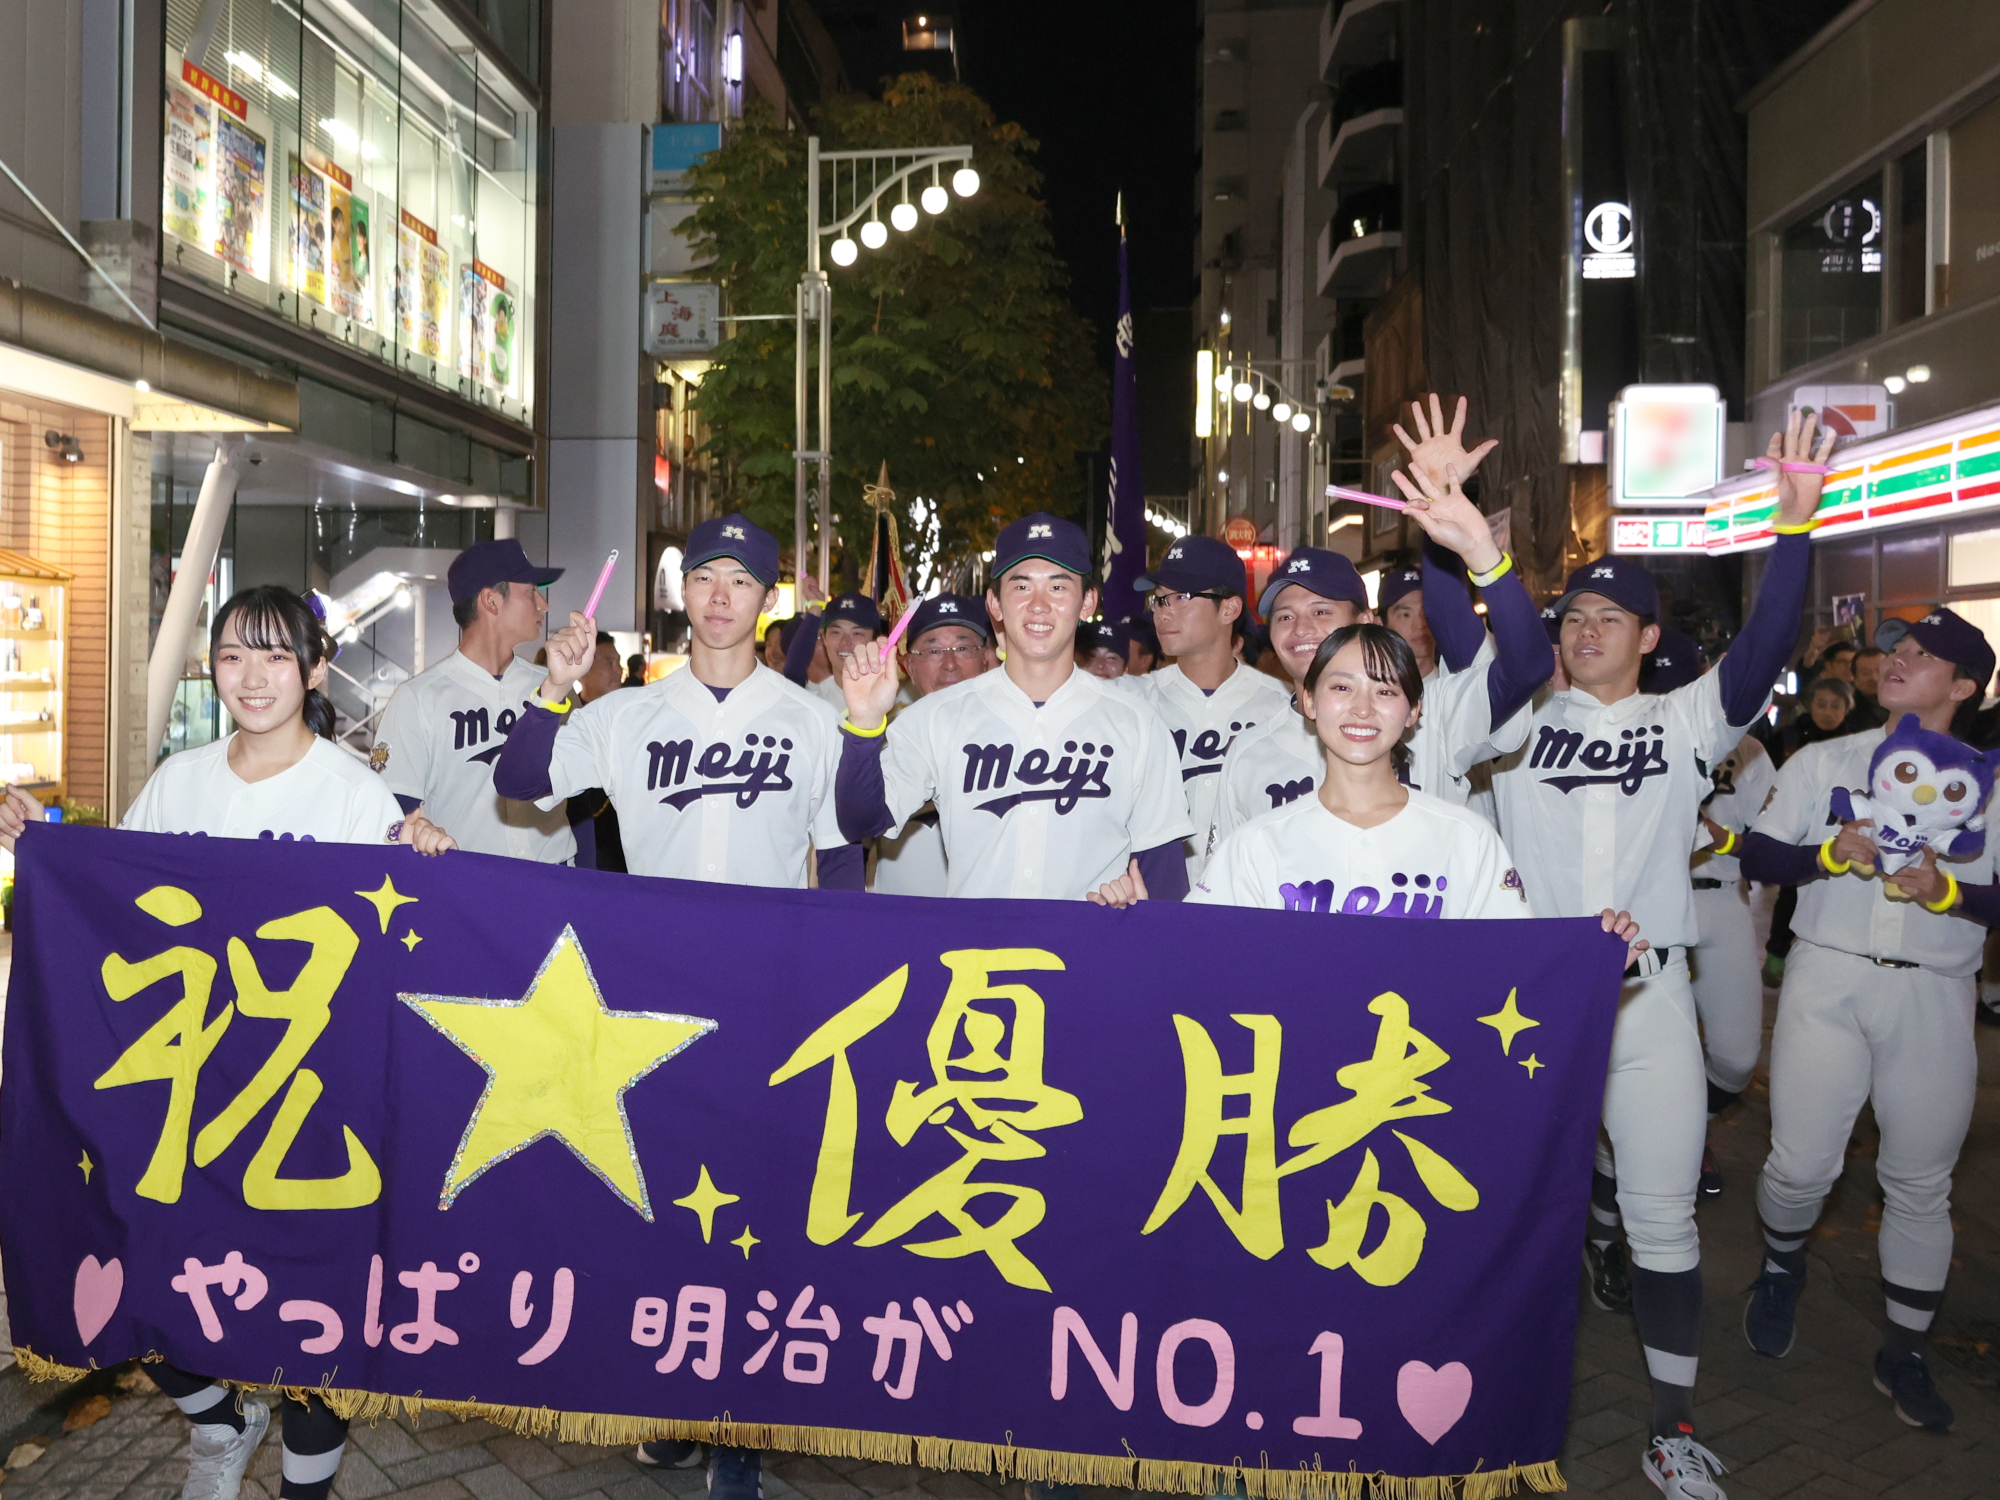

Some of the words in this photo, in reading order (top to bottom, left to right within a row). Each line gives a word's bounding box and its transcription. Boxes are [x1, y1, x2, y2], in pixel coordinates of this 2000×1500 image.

[1028, 525, 1052, 539] M
[94, 886, 382, 1210] 祝
[171, 1251, 575, 1367] やっぱり
[1050, 1306, 1363, 1441] NO.1
